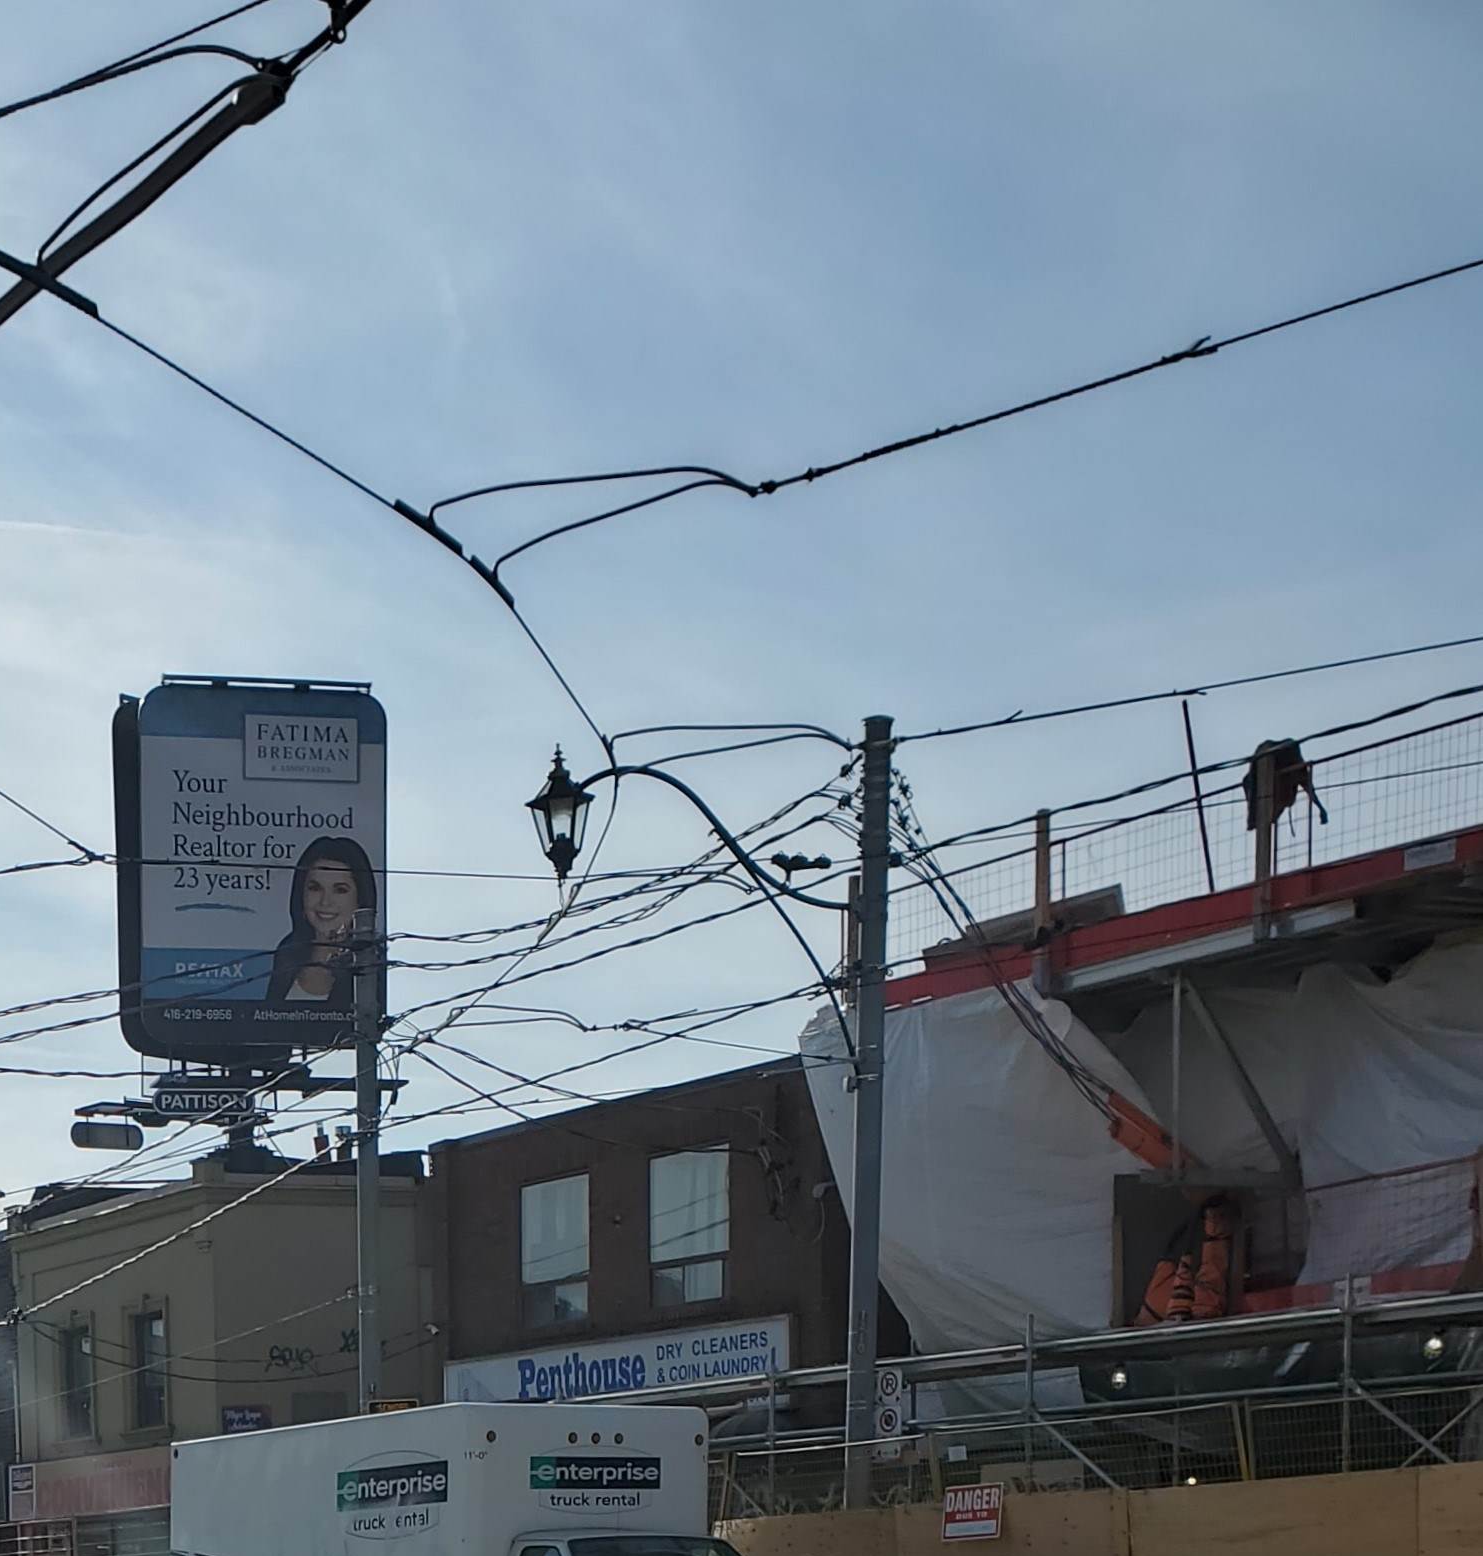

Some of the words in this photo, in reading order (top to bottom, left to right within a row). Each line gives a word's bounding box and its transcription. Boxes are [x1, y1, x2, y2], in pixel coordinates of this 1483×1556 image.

[257, 723, 349, 743] FATIMA
[257, 746, 350, 761] BREGMAN
[172, 769, 228, 793] Your
[172, 801, 354, 832] Neighbourhood
[173, 834, 257, 858] Realtor
[262, 836, 297, 859] for
[173, 866, 199, 889] 23
[205, 869, 271, 895] years!
[160, 1093, 247, 1110] PATTISON
[656, 1342, 682, 1361] DRY
[692, 1331, 768, 1356] CLEANERS
[518, 1352, 646, 1400] Penthouse
[656, 1367, 666, 1383] &
[669, 1363, 701, 1382] COIN
[704, 1354, 769, 1378] LAUNDRY
[536, 1461, 660, 1485] enterprise
[342, 1470, 447, 1501] enterprise
[550, 1492, 591, 1507] truck
[595, 1492, 640, 1507] rental
[946, 1488, 1000, 1512] DANGER
